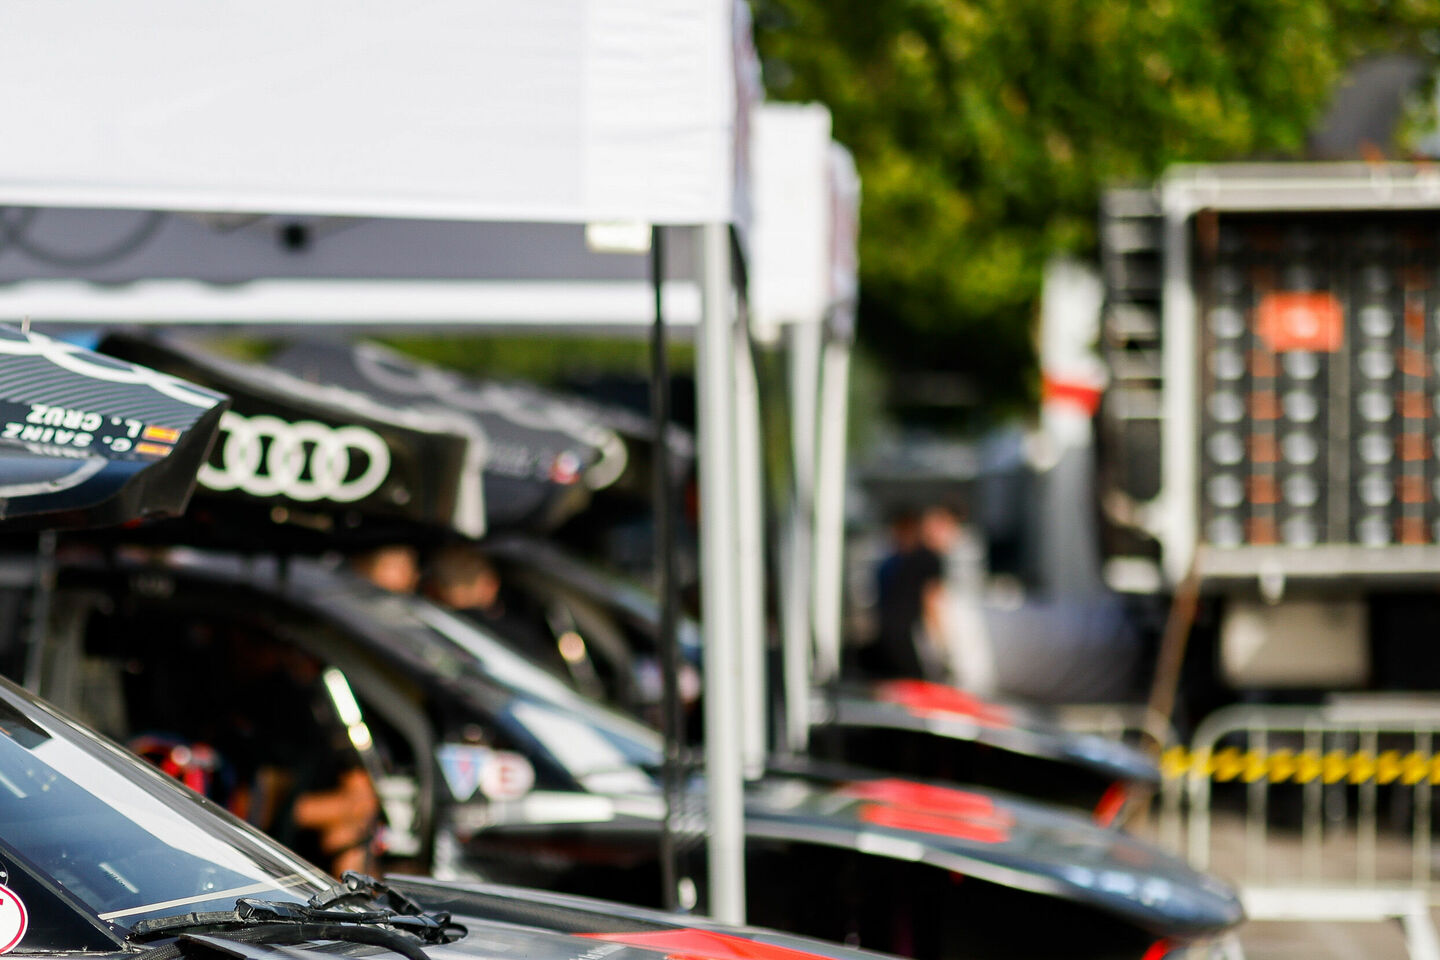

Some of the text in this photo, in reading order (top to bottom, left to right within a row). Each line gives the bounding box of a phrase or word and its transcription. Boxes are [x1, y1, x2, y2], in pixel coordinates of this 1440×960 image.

[0, 421, 95, 448] SAINZ
[25, 402, 144, 439] L. CRUZ
